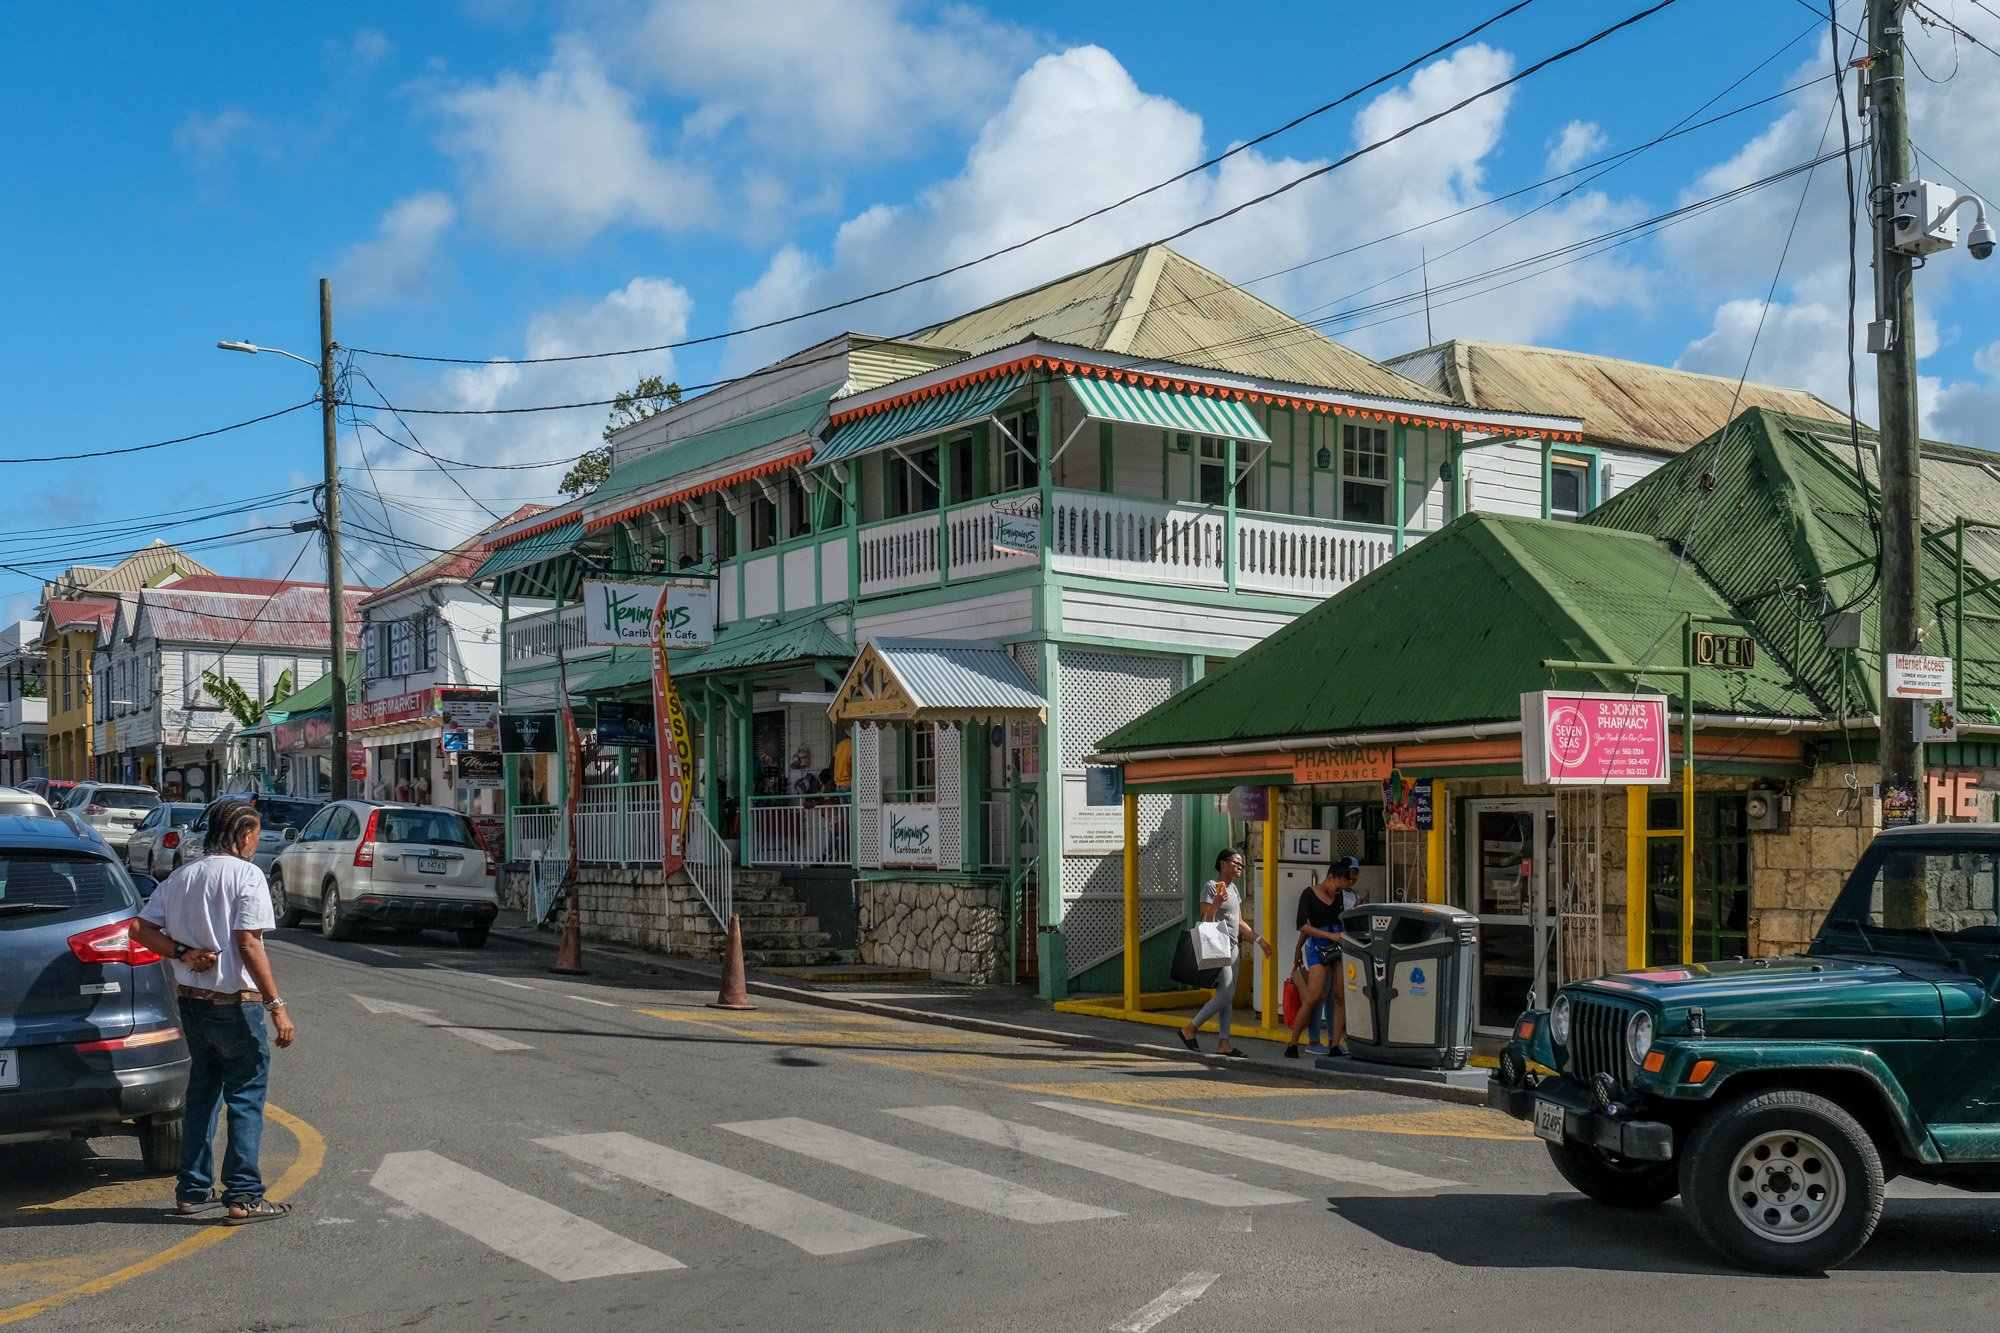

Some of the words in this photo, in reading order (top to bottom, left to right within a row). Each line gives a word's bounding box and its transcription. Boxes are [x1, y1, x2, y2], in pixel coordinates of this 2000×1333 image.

[675, 630, 697, 640] Cafe
[1700, 635, 1753, 666] OPEN
[1895, 654, 1922, 671] Internet
[1923, 657, 1945, 672] Access
[363, 693, 421, 720] SUPERMARKET
[1612, 703, 1646, 716] JOHN'S
[1555, 724, 1583, 737] SEVEN
[1597, 716, 1649, 730] PHARMACY
[1558, 736, 1580, 749] SEAS
[1295, 747, 1389, 768] PHARMACY
[1306, 767, 1378, 781] ENTRANCE
[1923, 771, 1979, 817] HE
[888, 810, 930, 856] Hemingways
[1293, 837, 1321, 856] ICE
